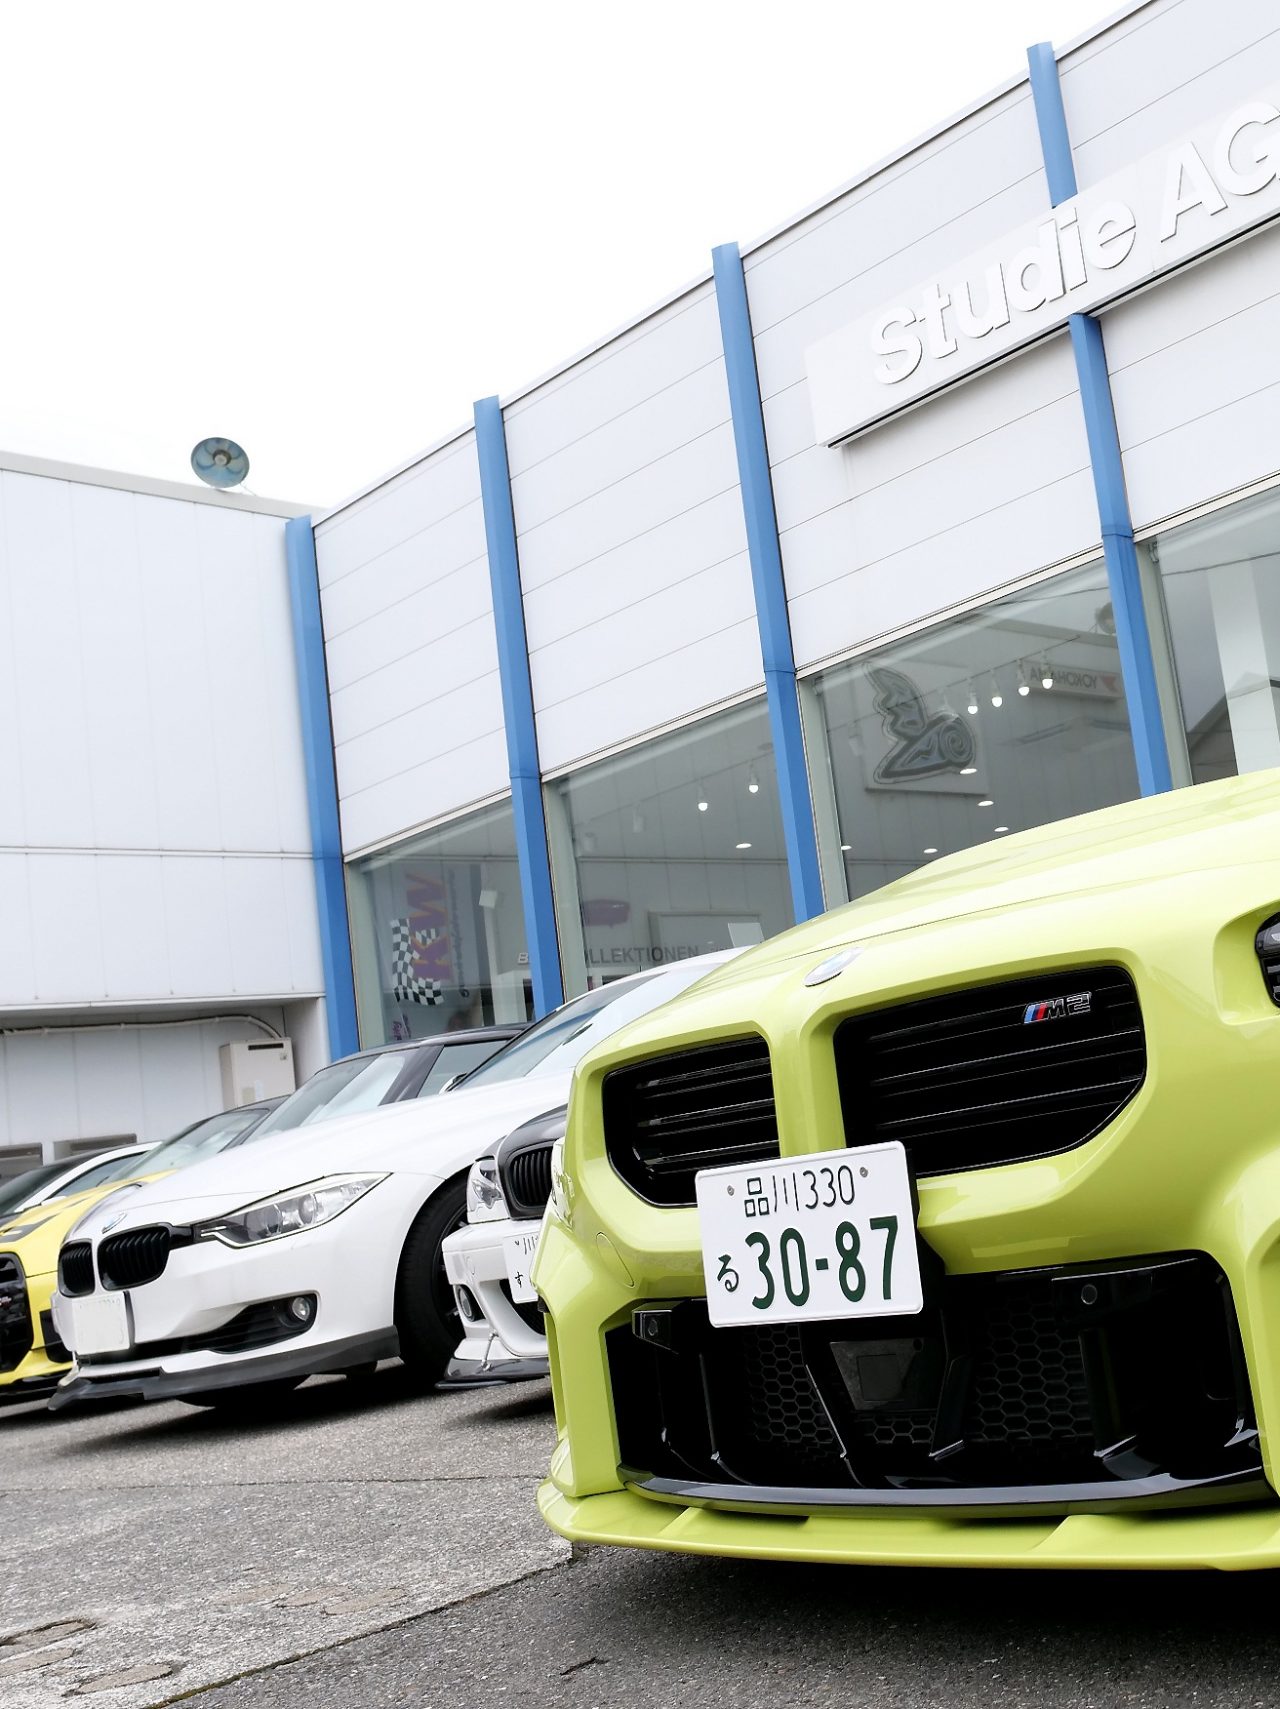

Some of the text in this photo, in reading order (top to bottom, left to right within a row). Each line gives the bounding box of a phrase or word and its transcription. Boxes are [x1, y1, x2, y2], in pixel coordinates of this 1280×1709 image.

[871, 199, 1137, 385] Studie
[717, 1215, 898, 1309] る 30-87
